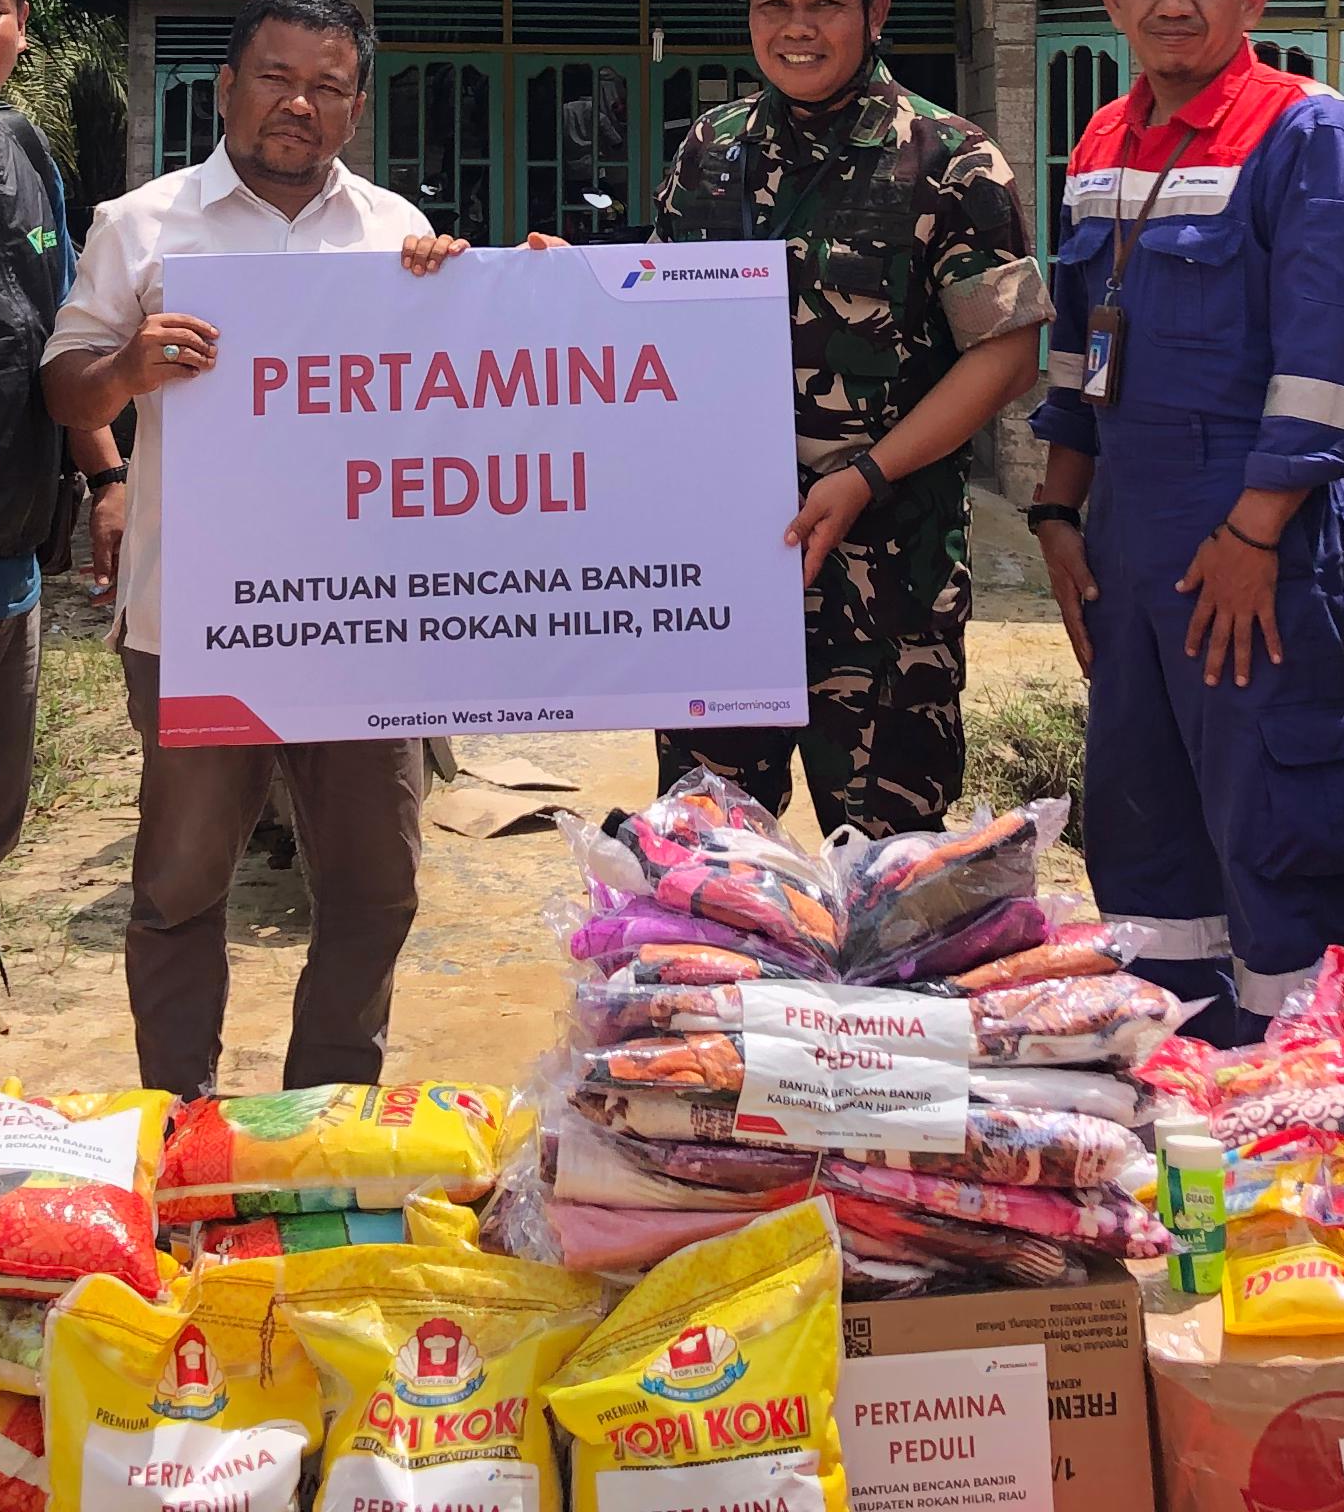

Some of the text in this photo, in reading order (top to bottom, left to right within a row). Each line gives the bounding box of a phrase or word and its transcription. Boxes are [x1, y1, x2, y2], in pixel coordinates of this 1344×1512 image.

[661, 265, 769, 282] PERTAMINA GAS
[252, 343, 678, 416] PERTAMINA
[346, 451, 587, 520] PEDULI
[233, 563, 703, 605] BANTUAN BENCANA BANJIR
[205, 605, 732, 651] KABUPATEN ROKAN HILIR, RIAU
[367, 707, 574, 730] Operation West Java Area
[707, 700, 791, 713] @pertaminagas
[785, 1006, 926, 1038] PERTAMINA
[815, 1046, 894, 1071] PEDULI
[779, 1079, 932, 1102] BANTUAN BENCANA BANJIR
[1185, 1192, 1215, 1205] GUARD
[1243, 1261, 1339, 1301] imoli
[1115, 1326, 1128, 1337] PT
[1047, 1377, 1082, 1389] KENTA
[96, 1407, 149, 1431] PREMIUM
[435, 1397, 529, 1446] KOKI
[596, 1400, 649, 1425] PREMIUM
[854, 1393, 1006, 1427] PERTAMINA
[606, 1412, 697, 1460] TOPI
[704, 1395, 811, 1451] KOKI
[889, 1435, 975, 1464] PEDULI
[127, 1448, 278, 1489] PERTAMINA
[851, 1475, 1017, 1497] BANTUAN BENCANA BANJIR
[854, 1490, 1028, 1512] BUPATEN ROKAN HILIR, RIAU
